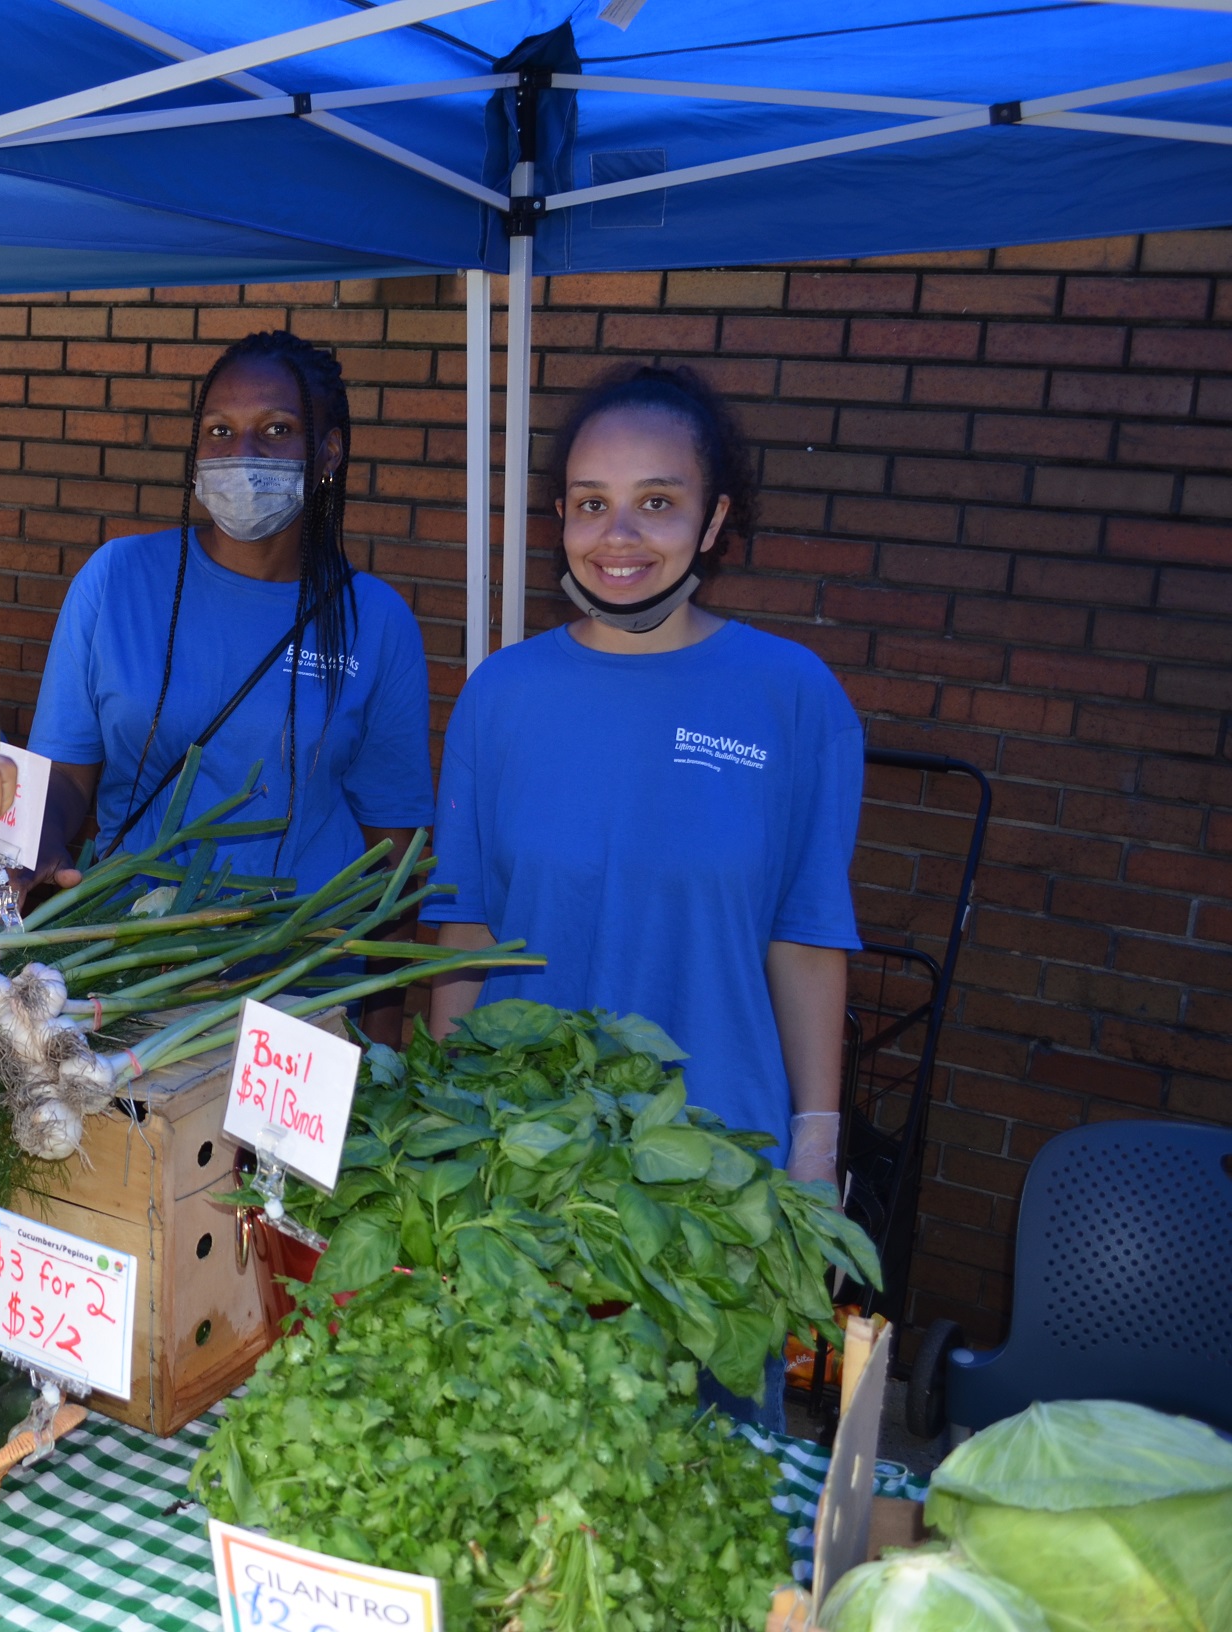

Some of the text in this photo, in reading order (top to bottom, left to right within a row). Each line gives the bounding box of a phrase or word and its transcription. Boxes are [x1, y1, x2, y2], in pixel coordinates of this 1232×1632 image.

[675, 727, 767, 761] BronxWorks
[675, 743, 764, 770] Lifting Lives, Building Futures
[248, 1029, 313, 1083] Basil
[17, 1227, 94, 1263] Cucumbers/Pepinos
[39, 1259, 75, 1298] for
[86, 1277, 116, 1324] 2
[1, 1290, 83, 1362] $3/2
[244, 1563, 411, 1626] CILANTRO
